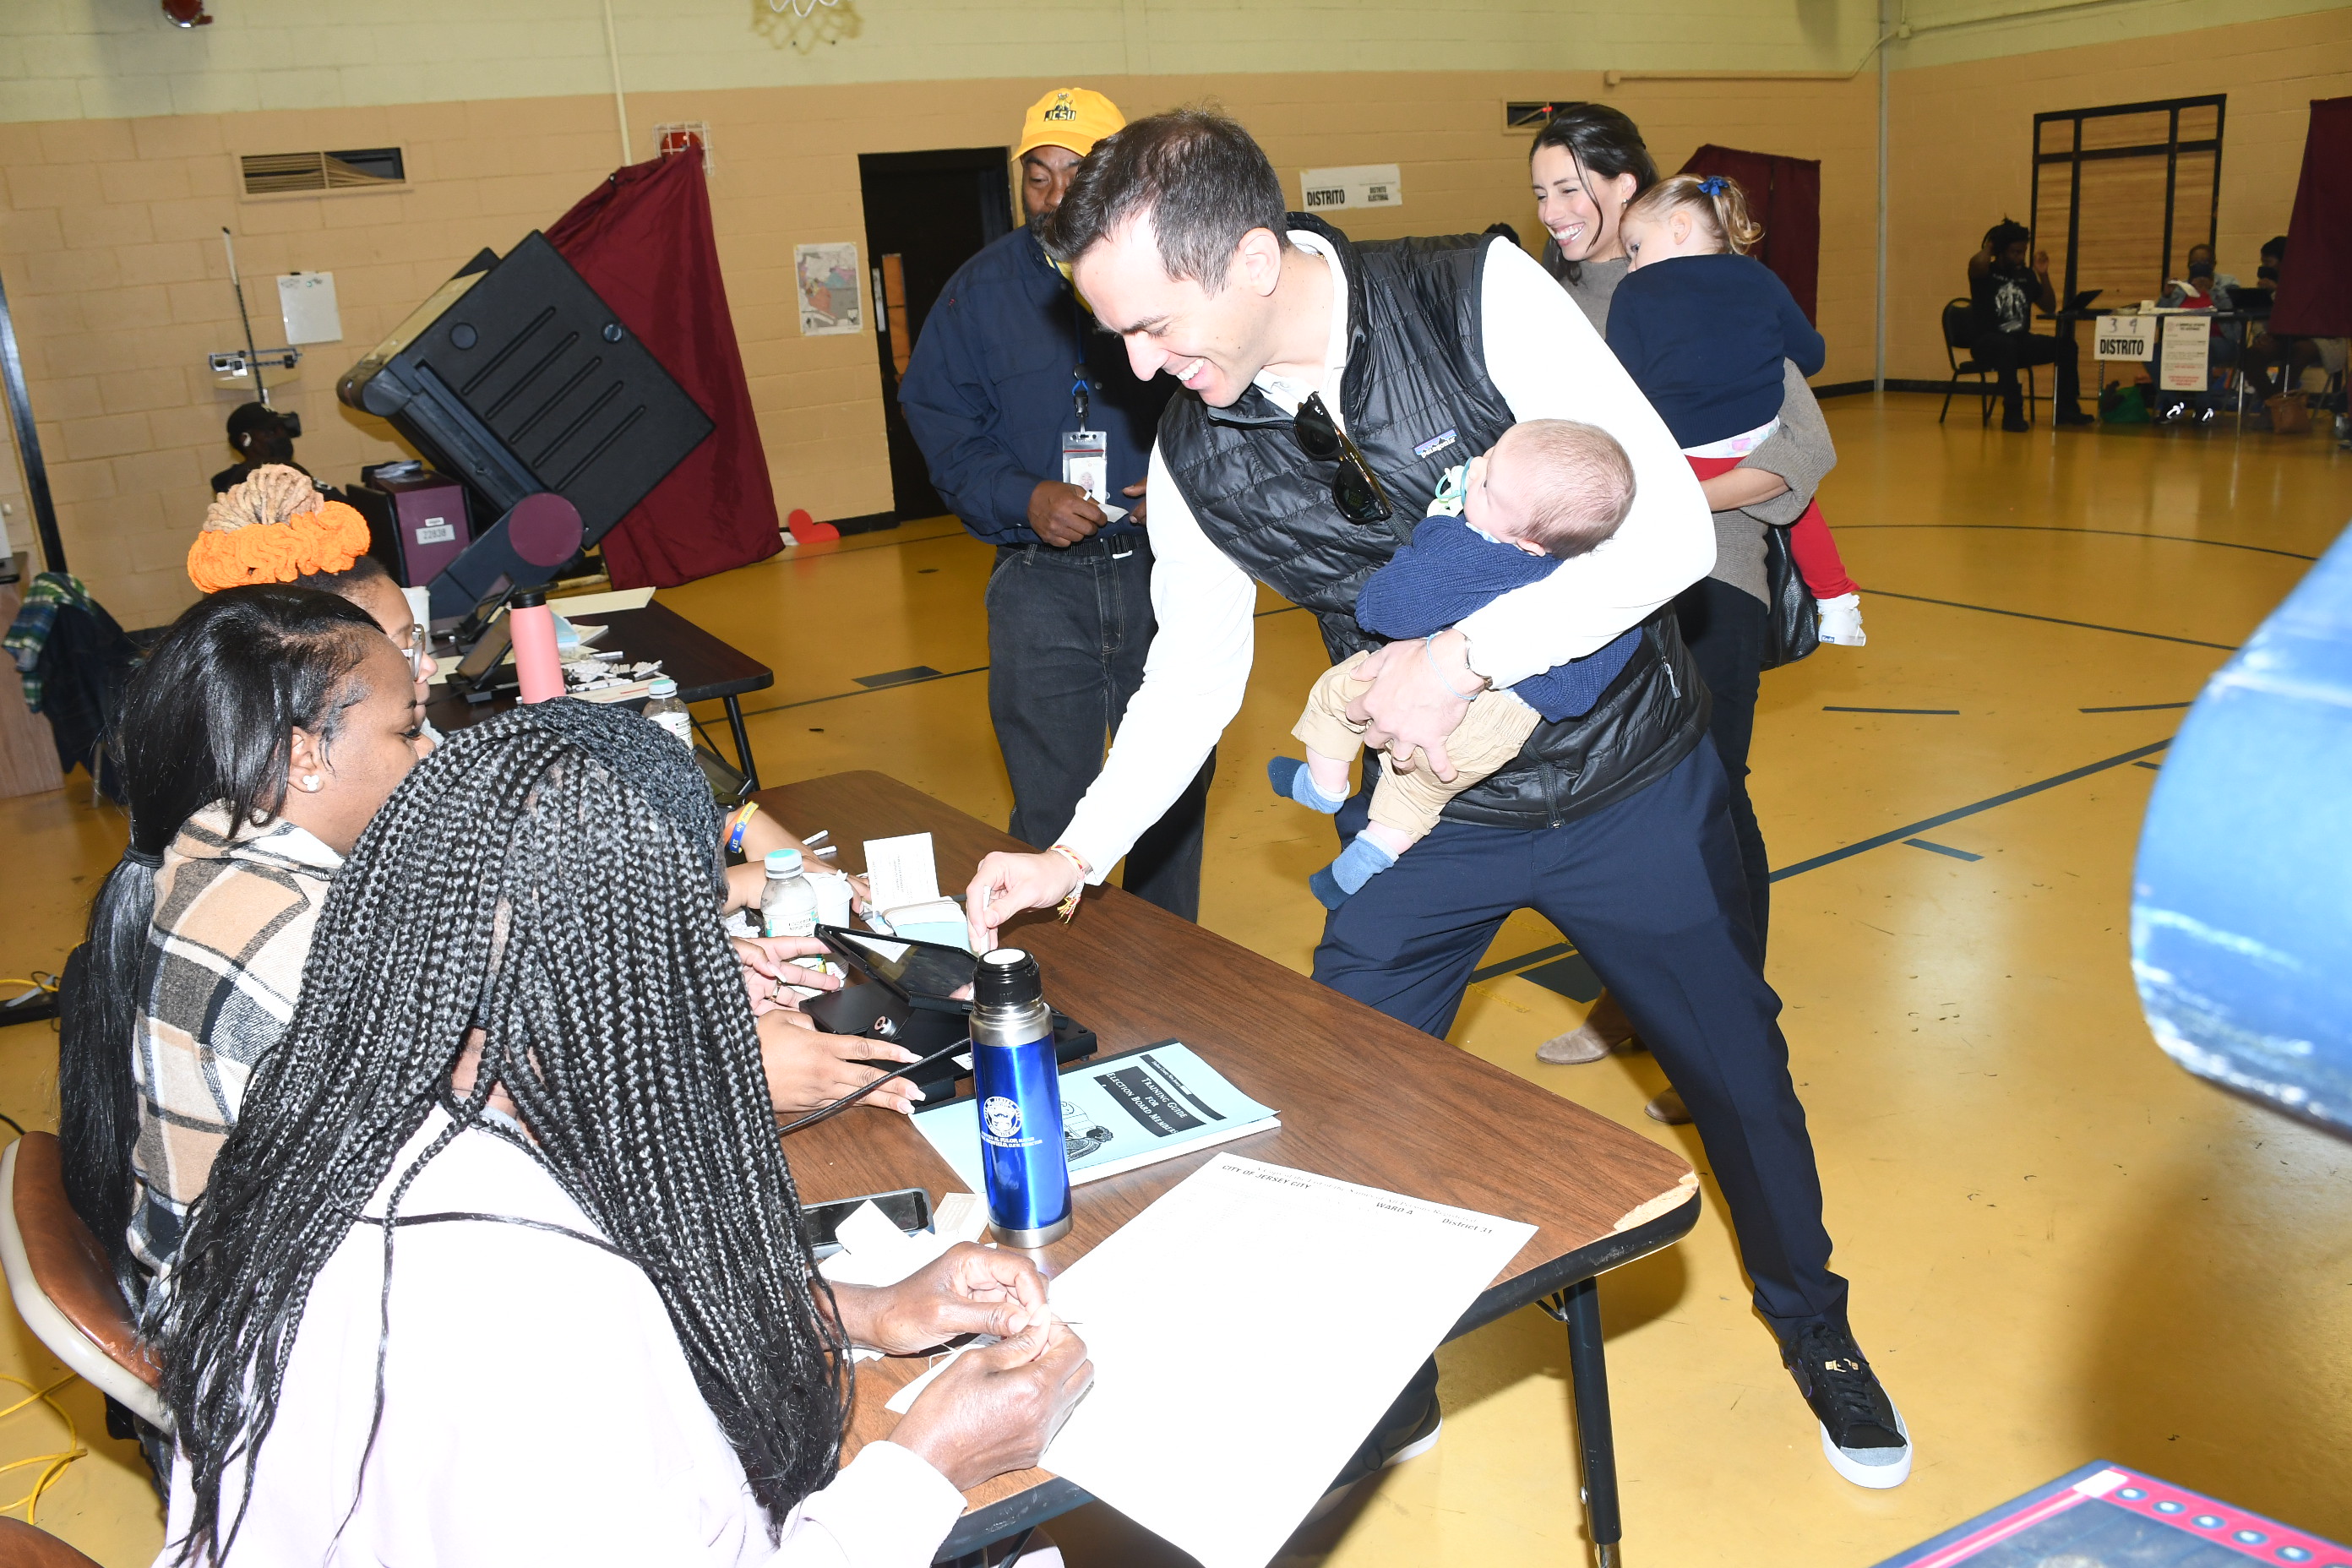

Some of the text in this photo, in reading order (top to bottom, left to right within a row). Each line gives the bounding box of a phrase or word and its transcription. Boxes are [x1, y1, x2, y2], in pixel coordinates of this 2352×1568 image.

[1045, 110, 1076, 121] JCSU
[1306, 188, 1345, 206] DISTRITO
[2099, 339, 2144, 355] DISTRITO
[1106, 1072, 1179, 1134] ELECTION BOARD MEMBERS
[1141, 1077, 1188, 1119] TRAINING GUIDE
[1145, 1096, 1159, 1108] FOR
[1255, 1173, 1290, 1184] JERSEY
[1290, 1181, 1312, 1190] CITY
[1376, 1201, 1405, 1212] WARD
[1441, 1218, 1478, 1231] District
